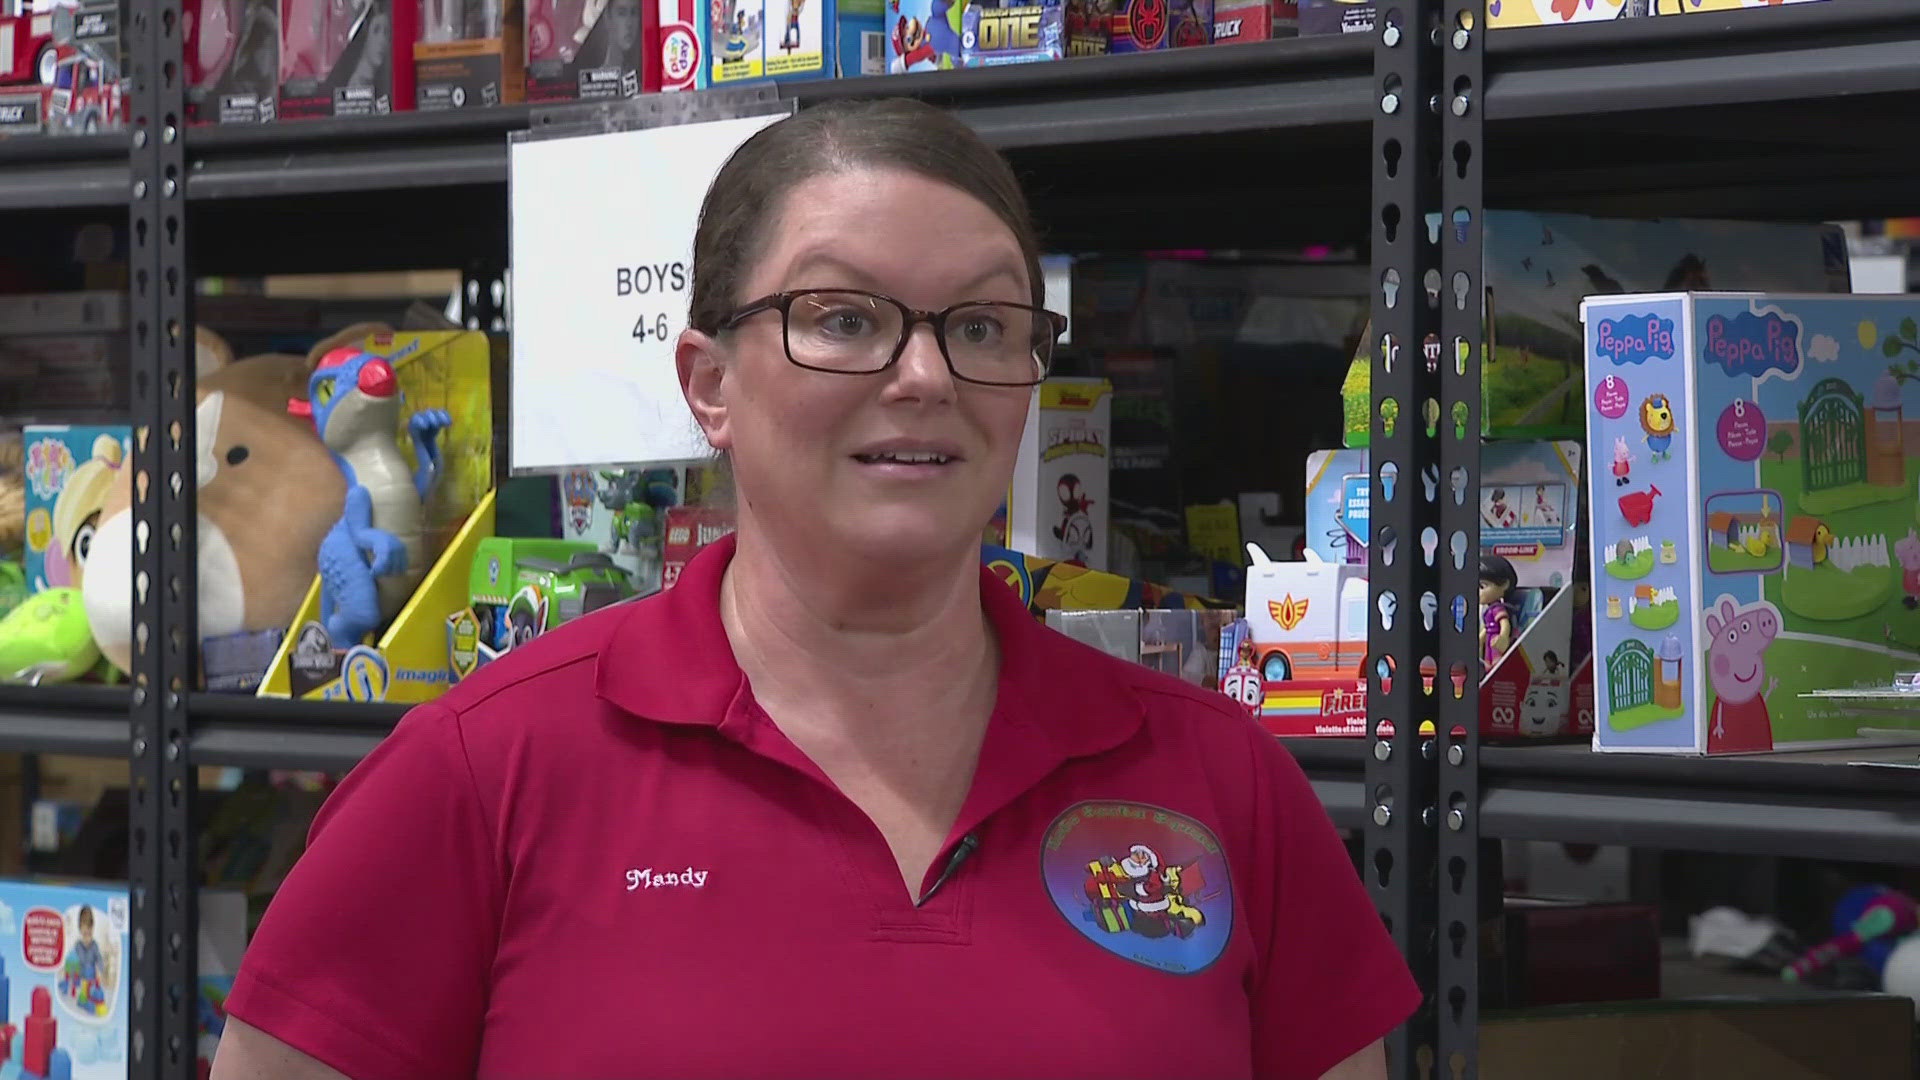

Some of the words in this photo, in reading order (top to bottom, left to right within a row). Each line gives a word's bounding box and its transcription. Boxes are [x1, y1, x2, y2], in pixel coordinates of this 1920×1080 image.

[979, 15, 1041, 50] ONE
[1214, 19, 1243, 39] RUCK
[679, 39, 689, 69] day
[617, 262, 685, 296] BOYS
[632, 312, 668, 343] 4-6
[1600, 321, 1646, 360] Peppa
[1648, 319, 1672, 353] Pig
[1709, 319, 1764, 368] Peppa
[1767, 319, 1795, 364] Pig
[1606, 374, 1614, 389] 8
[1734, 398, 1745, 418] 8
[626, 866, 709, 891] Mandy
